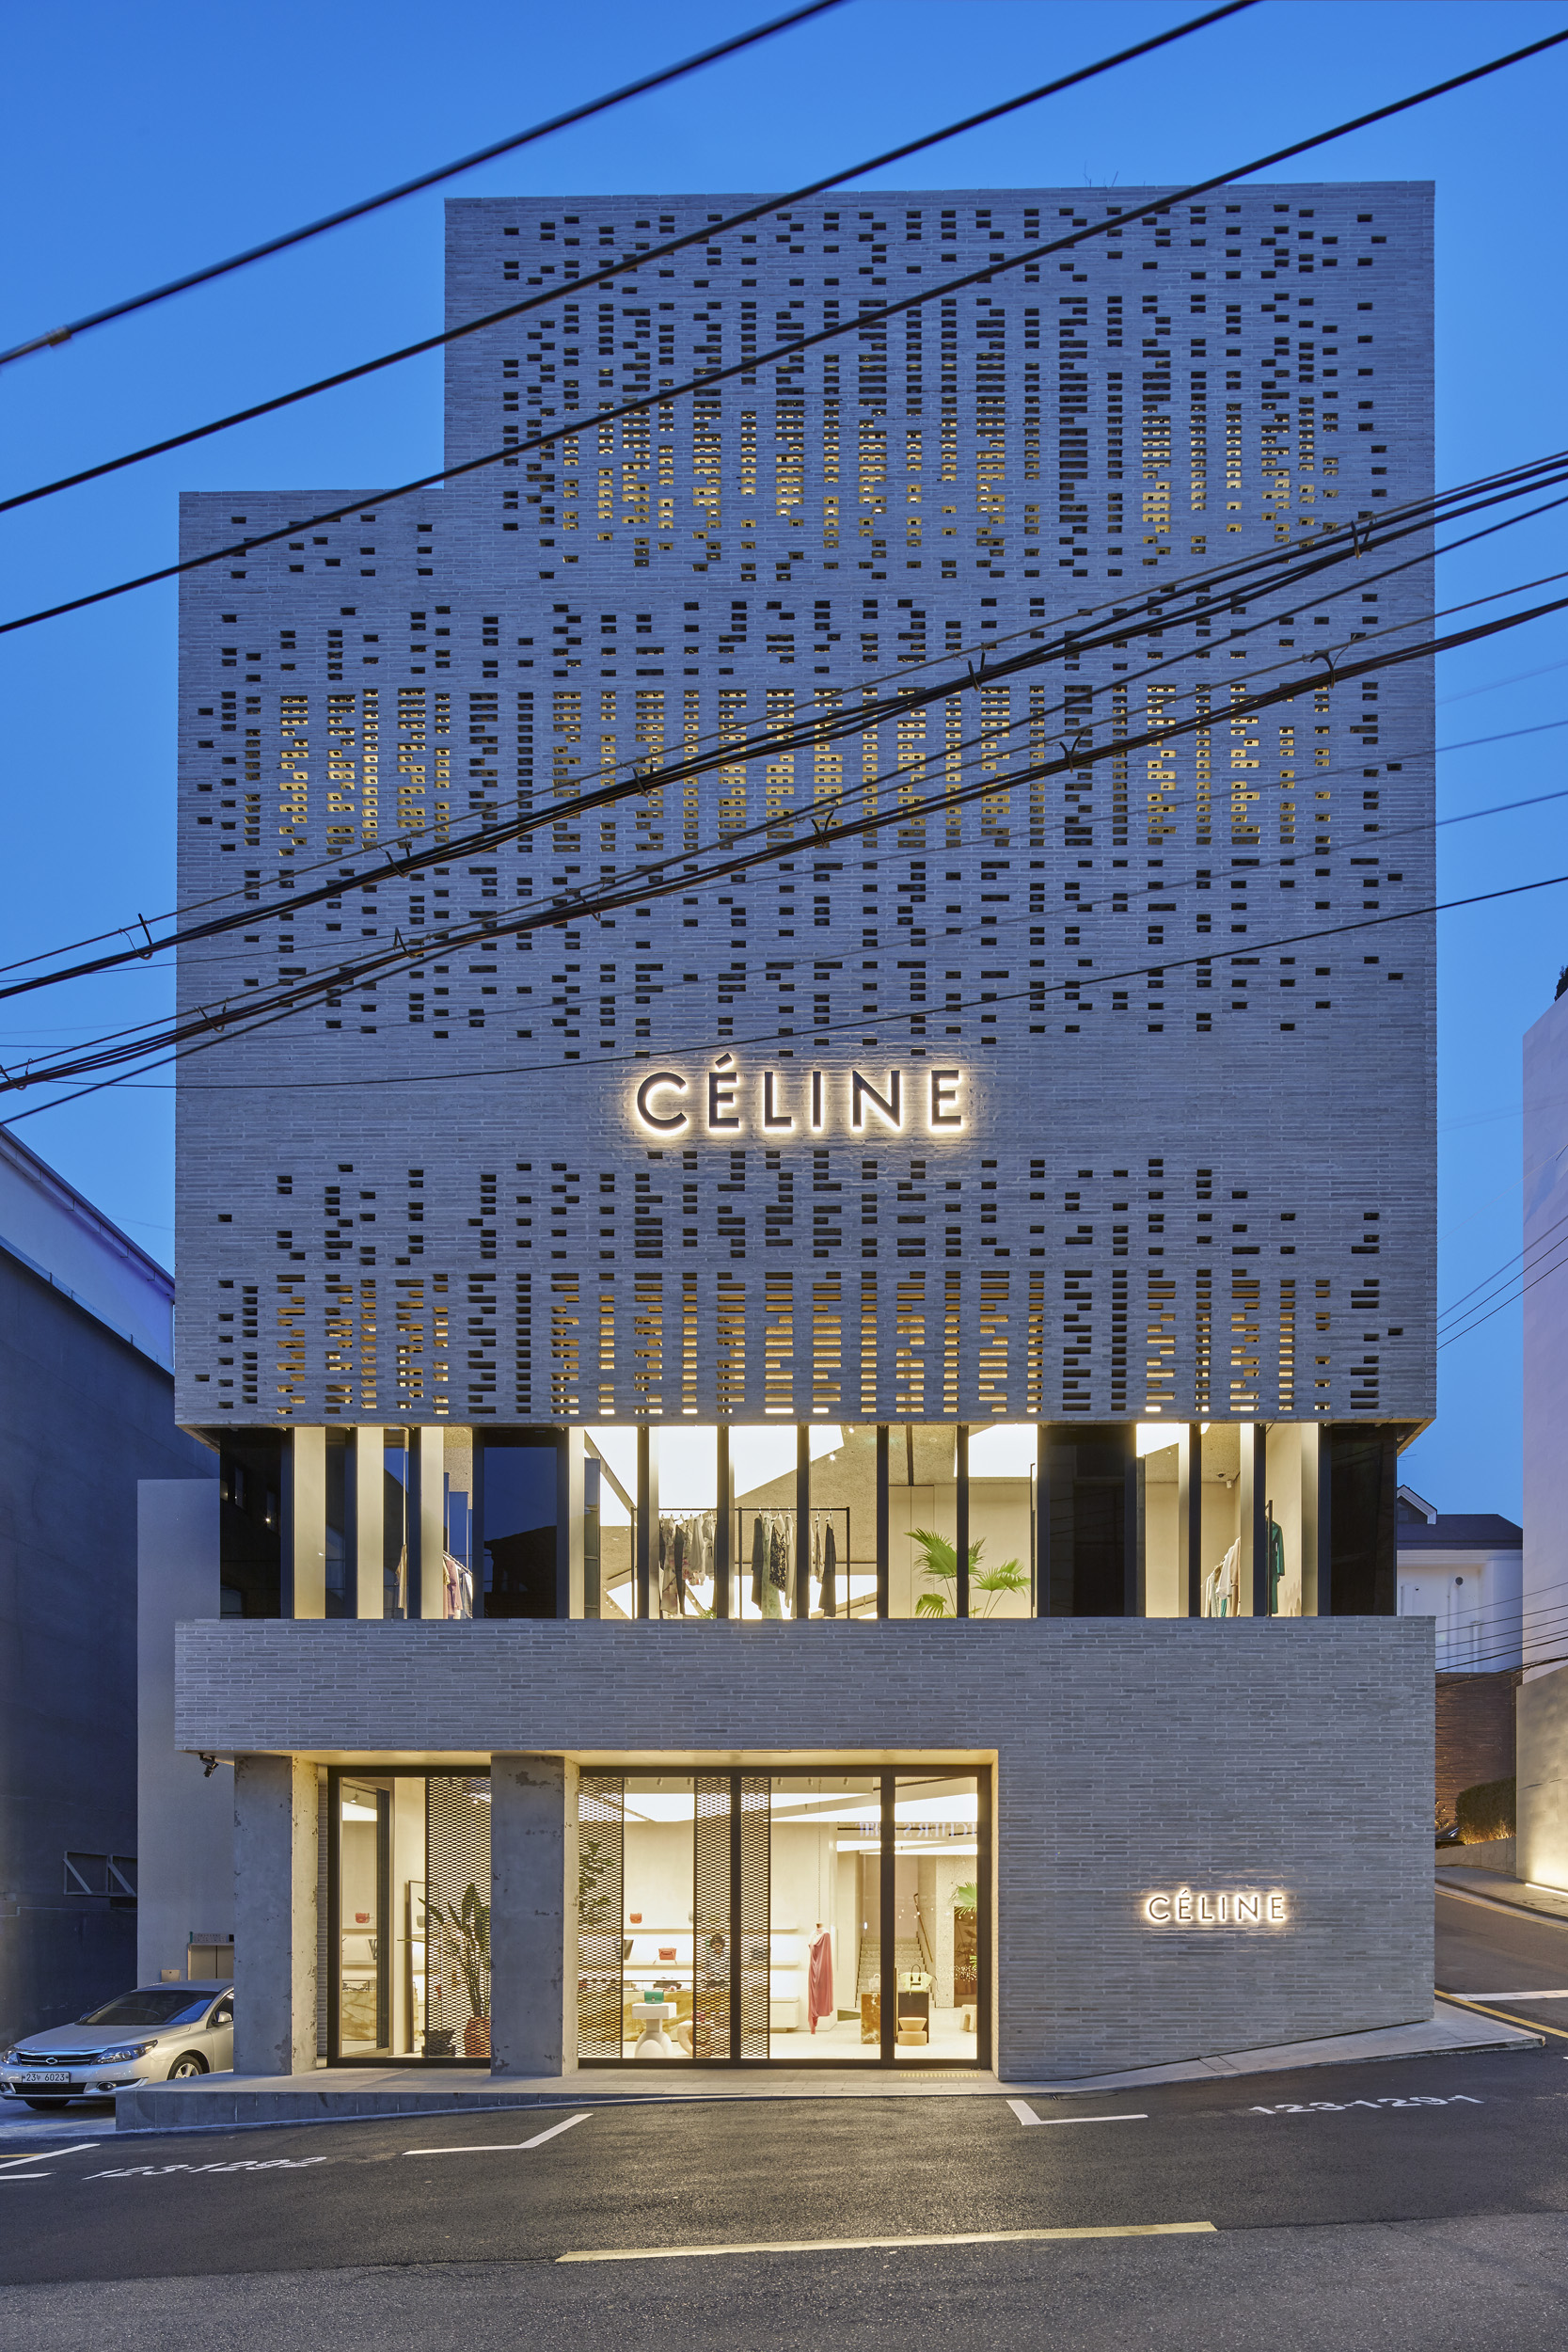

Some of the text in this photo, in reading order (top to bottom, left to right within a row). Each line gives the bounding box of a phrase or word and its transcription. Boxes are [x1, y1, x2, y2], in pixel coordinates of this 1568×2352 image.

[636, 1052, 962, 1131] CÉLINE
[1148, 1889, 1284, 1920] CÉLINE
[44, 2073, 65, 2082] 6023
